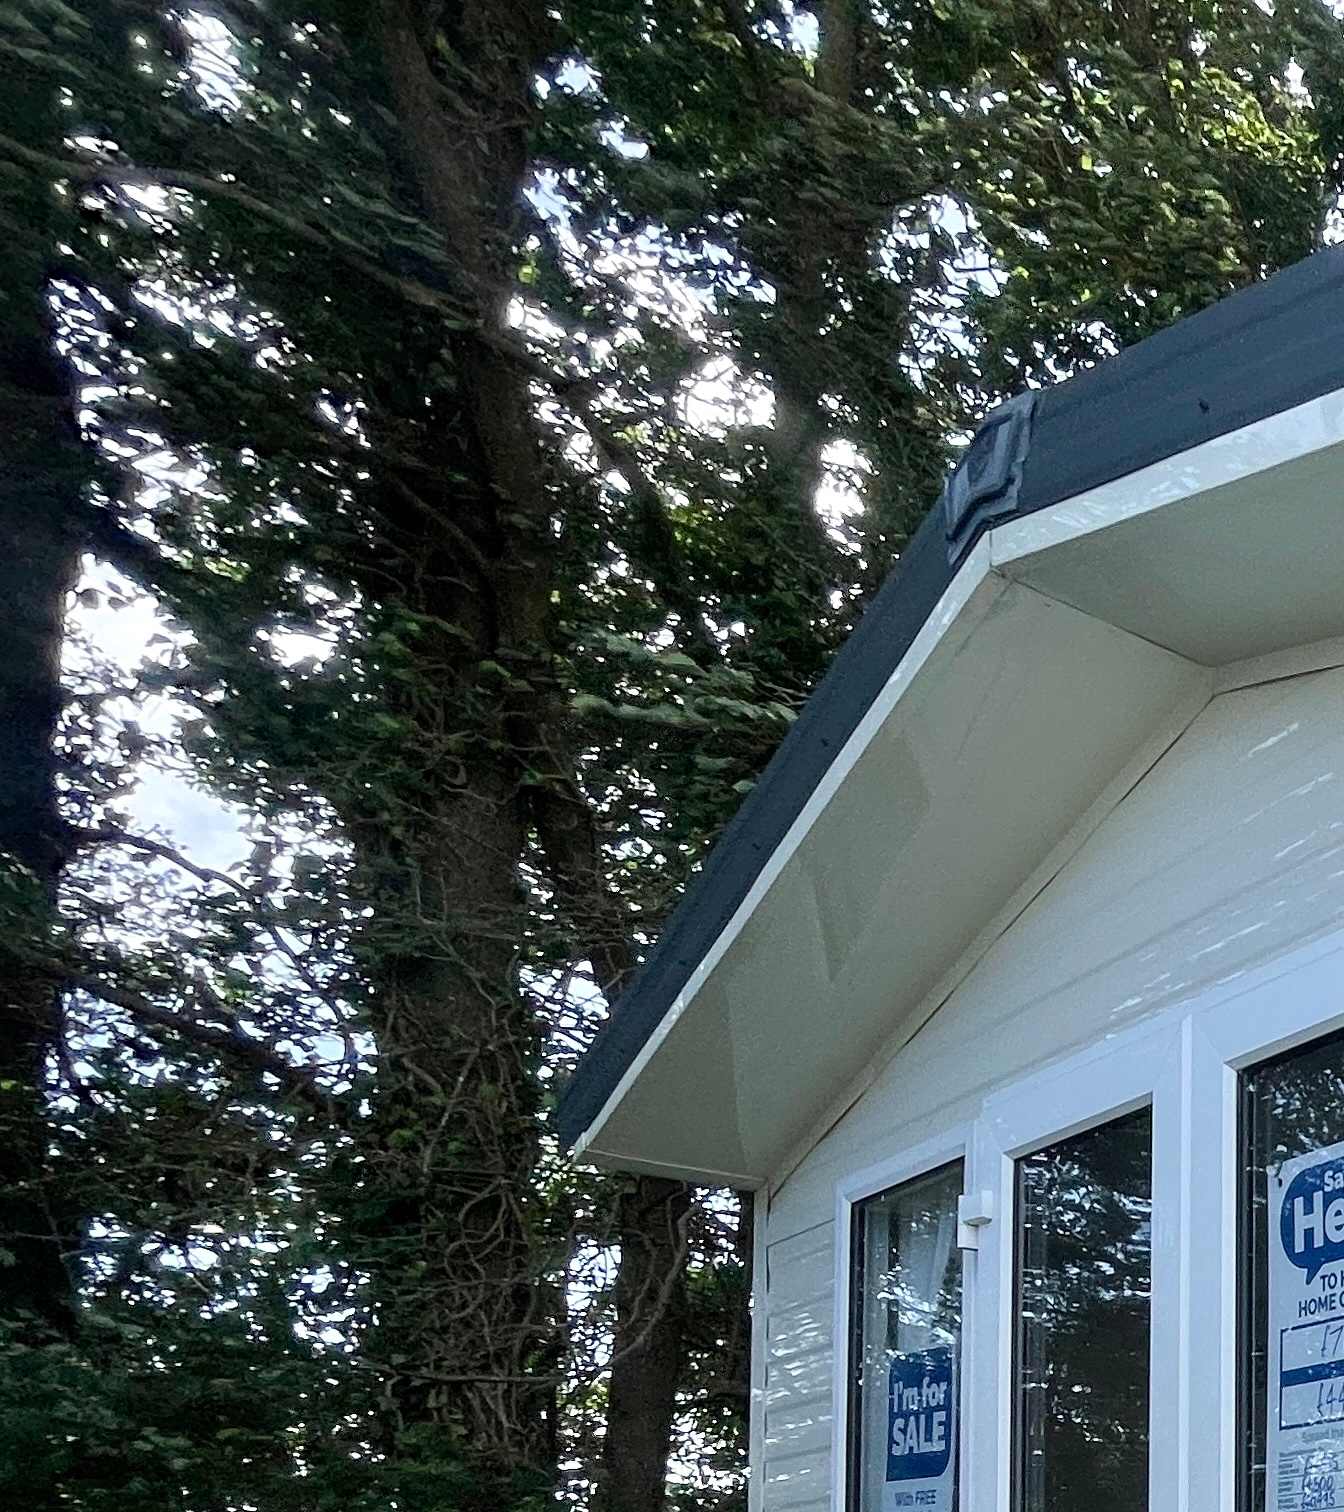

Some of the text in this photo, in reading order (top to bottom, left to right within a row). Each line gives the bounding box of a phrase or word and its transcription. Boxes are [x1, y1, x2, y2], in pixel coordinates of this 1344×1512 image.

[1320, 1273, 1337, 1292] TO
[1298, 1295, 1337, 1318] HOME
[893, 1376, 947, 1413] I'm for
[891, 1410, 947, 1456] SALE
